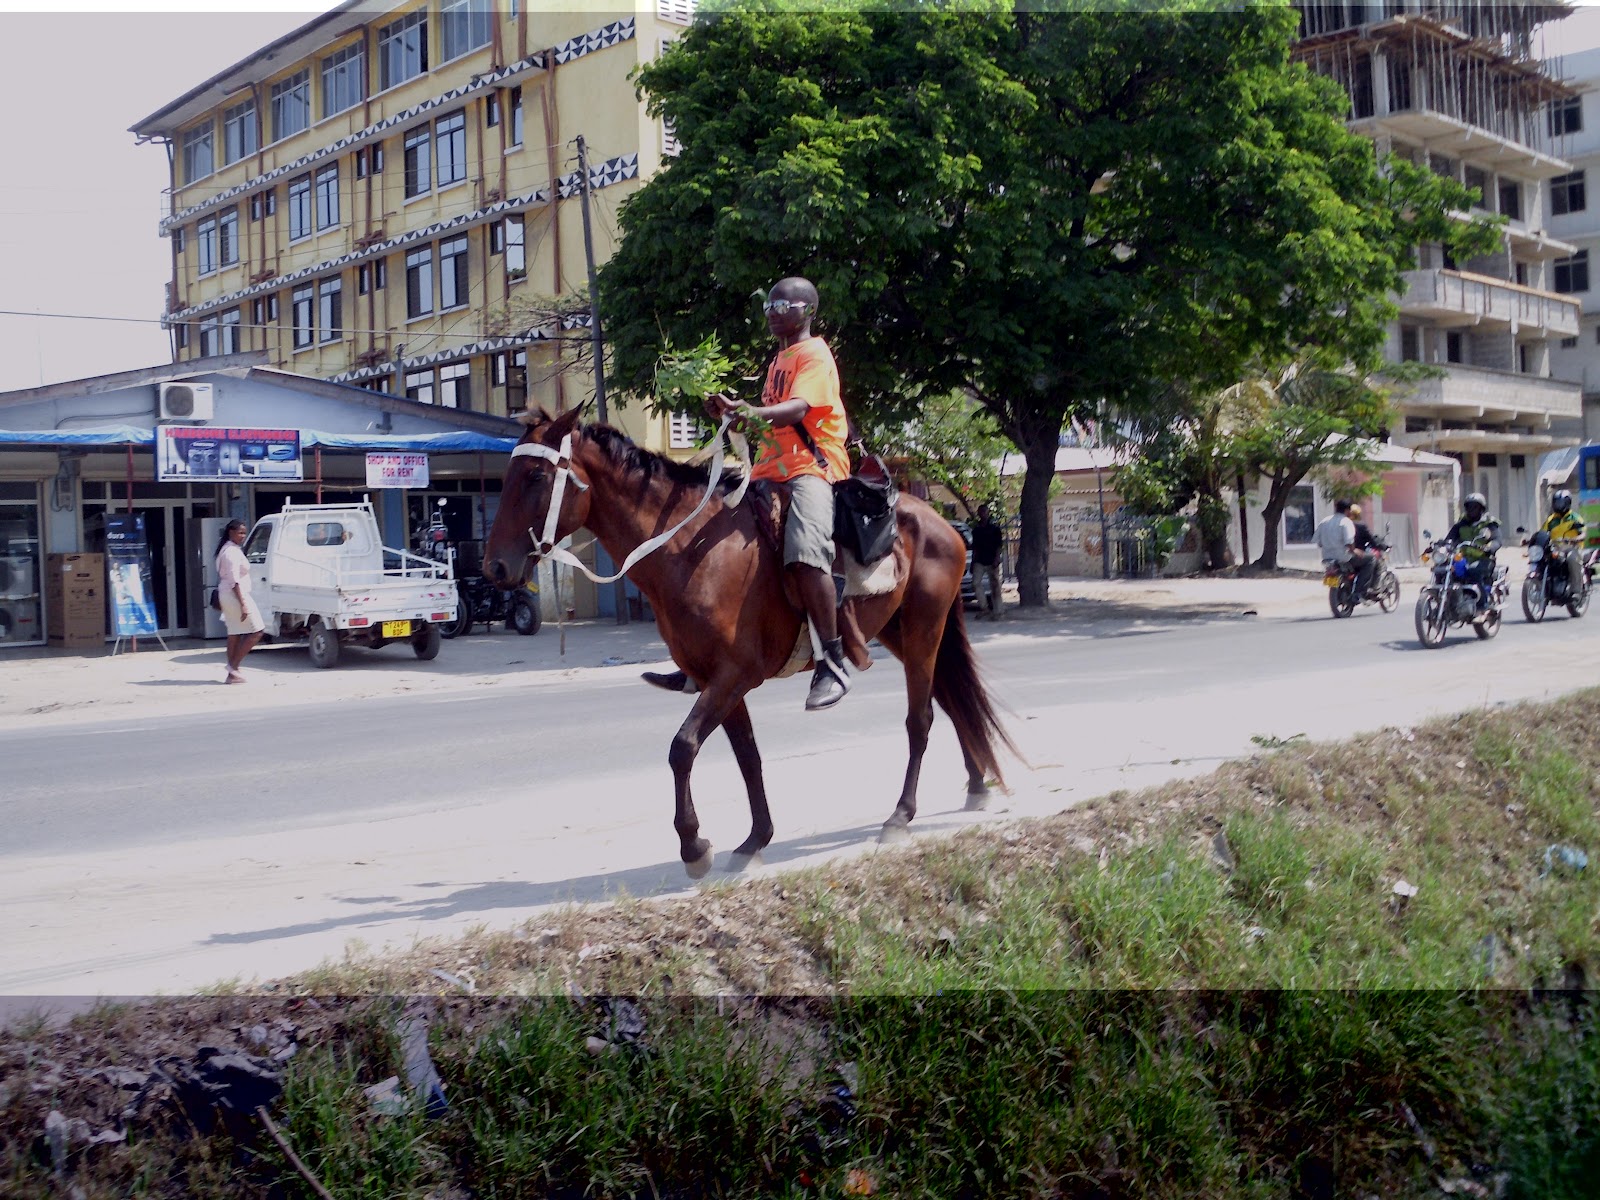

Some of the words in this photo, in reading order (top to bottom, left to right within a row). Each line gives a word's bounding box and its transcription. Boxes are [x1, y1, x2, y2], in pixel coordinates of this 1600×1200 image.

[227, 428, 297, 440] ELECTRONICS
[367, 455, 384, 465] SHOP
[388, 455, 400, 465] AND
[403, 455, 425, 466] OFFICE
[382, 467, 395, 477] FOR
[397, 467, 414, 478] RENT
[1059, 513, 1079, 521] HOT
[1054, 524, 1080, 533] CRYS
